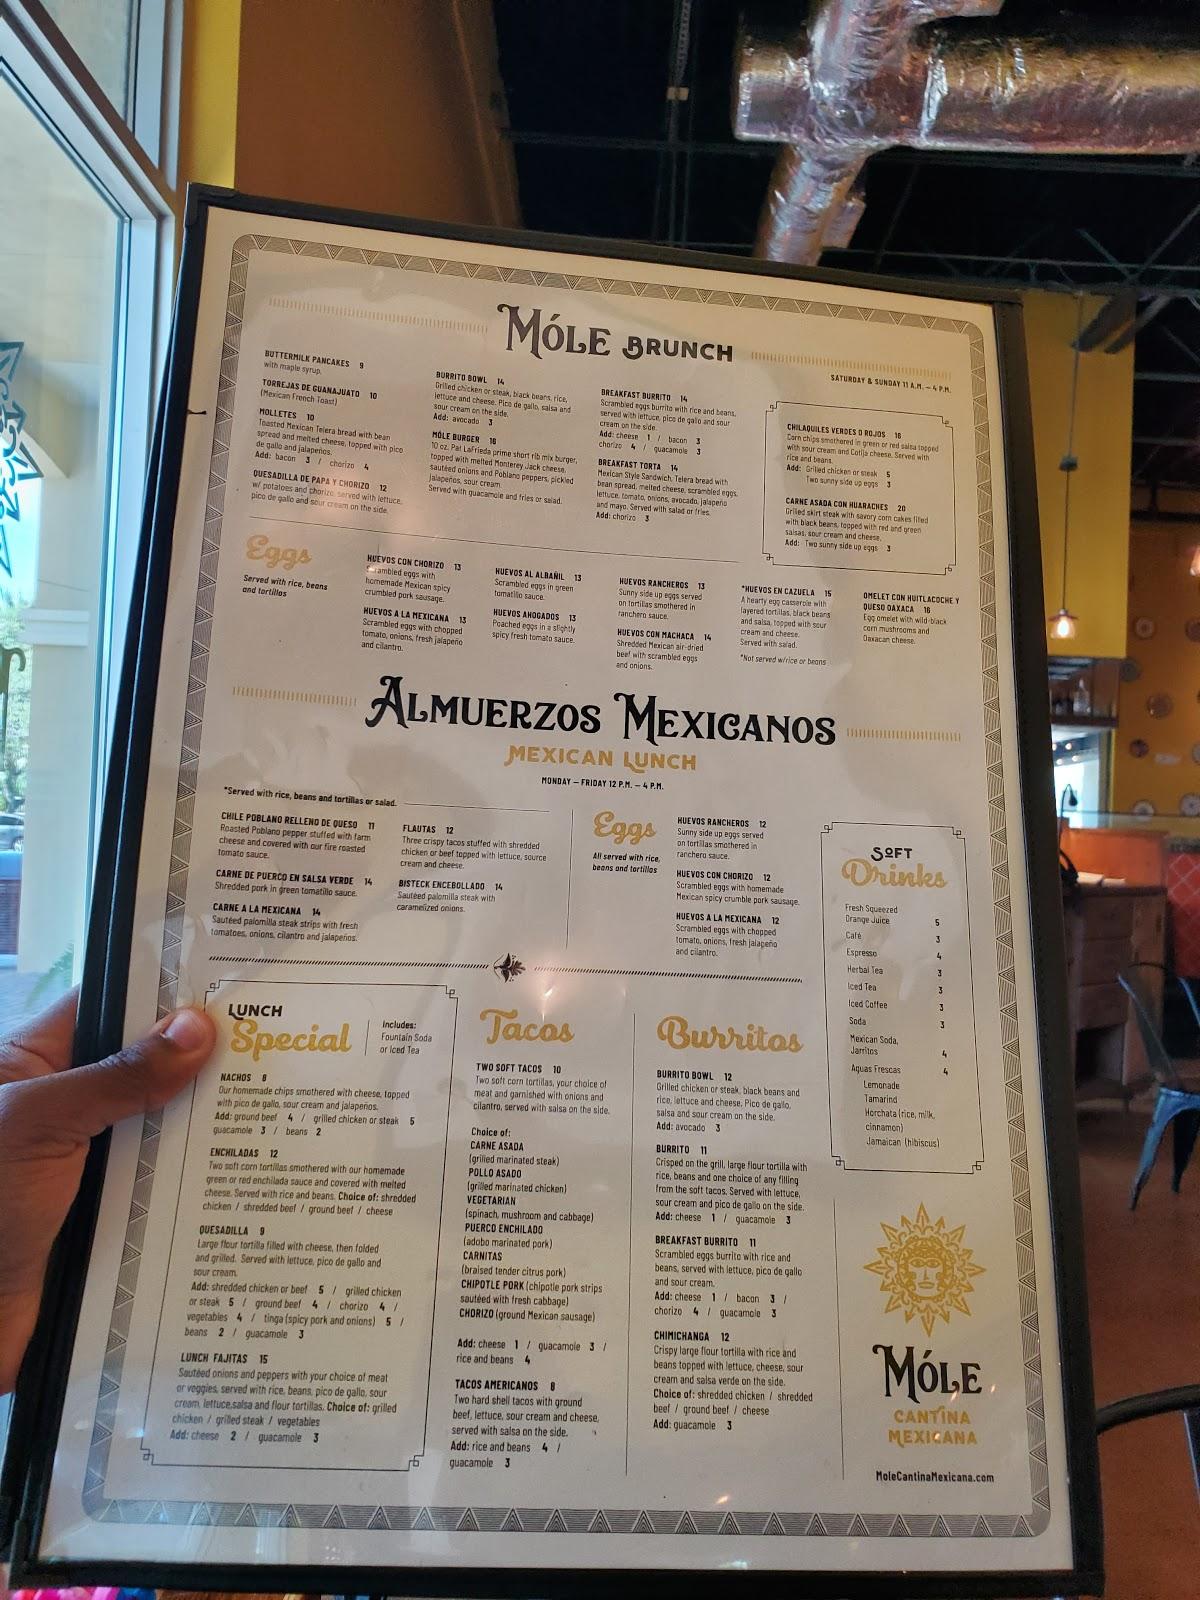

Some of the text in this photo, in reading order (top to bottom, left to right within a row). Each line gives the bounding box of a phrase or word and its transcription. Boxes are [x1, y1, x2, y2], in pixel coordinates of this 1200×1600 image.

[622, 336, 732, 362] BRUNCH
[265, 350, 310, 362] BUTTERMILK
[312, 356, 350, 367] PANCAKES
[436, 371, 466, 381] BURRITO
[468, 374, 487, 384] BOWL
[831, 374, 865, 384] SATURDAY
[875, 378, 900, 387] SUNDAY
[601, 388, 640, 398] BREAKFAST
[642, 392, 671, 401] BURRITO
[259, 408, 297, 419] MOLLETES
[787, 423, 829, 434] CHILAQUILES
[832, 427, 856, 436] VERDES
[864, 430, 886, 438] ROJOS
[452, 433, 479, 443] BURGER
[598, 458, 637, 468] BREAKFAST
[640, 462, 661, 470] TORTA
[849, 502, 888, 511] HUARACHES
[246, 535, 312, 570] Eggs
[367, 554, 396, 564] HUEVOS
[397, 558, 412, 566] CON
[414, 559, 444, 569] CHORIZO
[495, 568, 523, 577] HUEVOS
[243, 574, 269, 584] Served
[271, 578, 286, 586] with
[306, 581, 328, 590] beans
[620, 578, 646, 586] HUEVOS
[648, 580, 688, 589] RANCHEROS
[258, 588, 287, 597] tortillas
[785, 588, 814, 596] CAZUELA
[493, 609, 520, 618] HUEVOS
[523, 611, 559, 621] AHOGADOS
[365, 675, 836, 746] ALMUERZOS MEXICANOS
[504, 745, 696, 774] MEXICAN LUNCH
[542, 777, 571, 785] MONDAY
[581, 778, 606, 787] FRIDAY
[678, 817, 705, 825] HUEVOS
[707, 818, 749, 827] RANCHEROS
[402, 824, 436, 834] FLAUTAS
[594, 811, 656, 845] Eggs
[870, 847, 912, 862] SOFT
[841, 858, 947, 888] Drinks
[845, 904, 898, 914] Fresh Squeezed
[846, 914, 869, 925] Orange
[871, 916, 890, 925] Juice
[845, 931, 862, 941] Café
[846, 948, 877, 958] Espresso
[228, 1004, 282, 1020] LUNCH
[383, 1020, 416, 1029] Includes:
[480, 1009, 574, 1044] Tacos
[230, 1018, 352, 1061] Special
[381, 1032, 432, 1042] Fountain Soda
[657, 1015, 803, 1053] Burritos
[390, 1045, 405, 1054] Iced
[408, 1045, 420, 1054] Tea
[476, 1063, 494, 1072] TWO
[496, 1064, 515, 1072] SOFT
[518, 1064, 542, 1074] TACOS
[220, 1073, 251, 1082] NACHOS
[657, 1070, 690, 1079] BURRITO
[692, 1071, 714, 1080] BOWL
[864, 1080, 900, 1090] Lemonade
[471, 1127, 510, 1137] Choice of:
[470, 1140, 524, 1151] CARNE ASADA
[210, 1148, 259, 1158] ENCHILADAS
[469, 1154, 559, 1167] (grilled marinated steak)
[199, 1225, 248, 1235] QUESADILLA
[655, 1235, 702, 1245] BREAKFAST
[704, 1237, 738, 1247] BURRITO
[654, 1330, 710, 1341] CHIMICHANGA
[181, 1352, 209, 1362] LUNCH
[213, 1353, 248, 1364] FAJITAS
[456, 1379, 482, 1389] TACOS
[484, 1380, 538, 1391] AMERICANOS
[654, 1376, 678, 1384] cream
[680, 1375, 694, 1384] and
[697, 1375, 716, 1385] salsa
[719, 1376, 739, 1386] verde
[753, 1377, 765, 1386] the
[768, 1376, 786, 1386] side.
[455, 1394, 582, 1409] Two hard shell tacos with ground
[888, 1428, 977, 1448] MEXICANA
[876, 1471, 994, 1482] MoleCantinaMexicana.com
